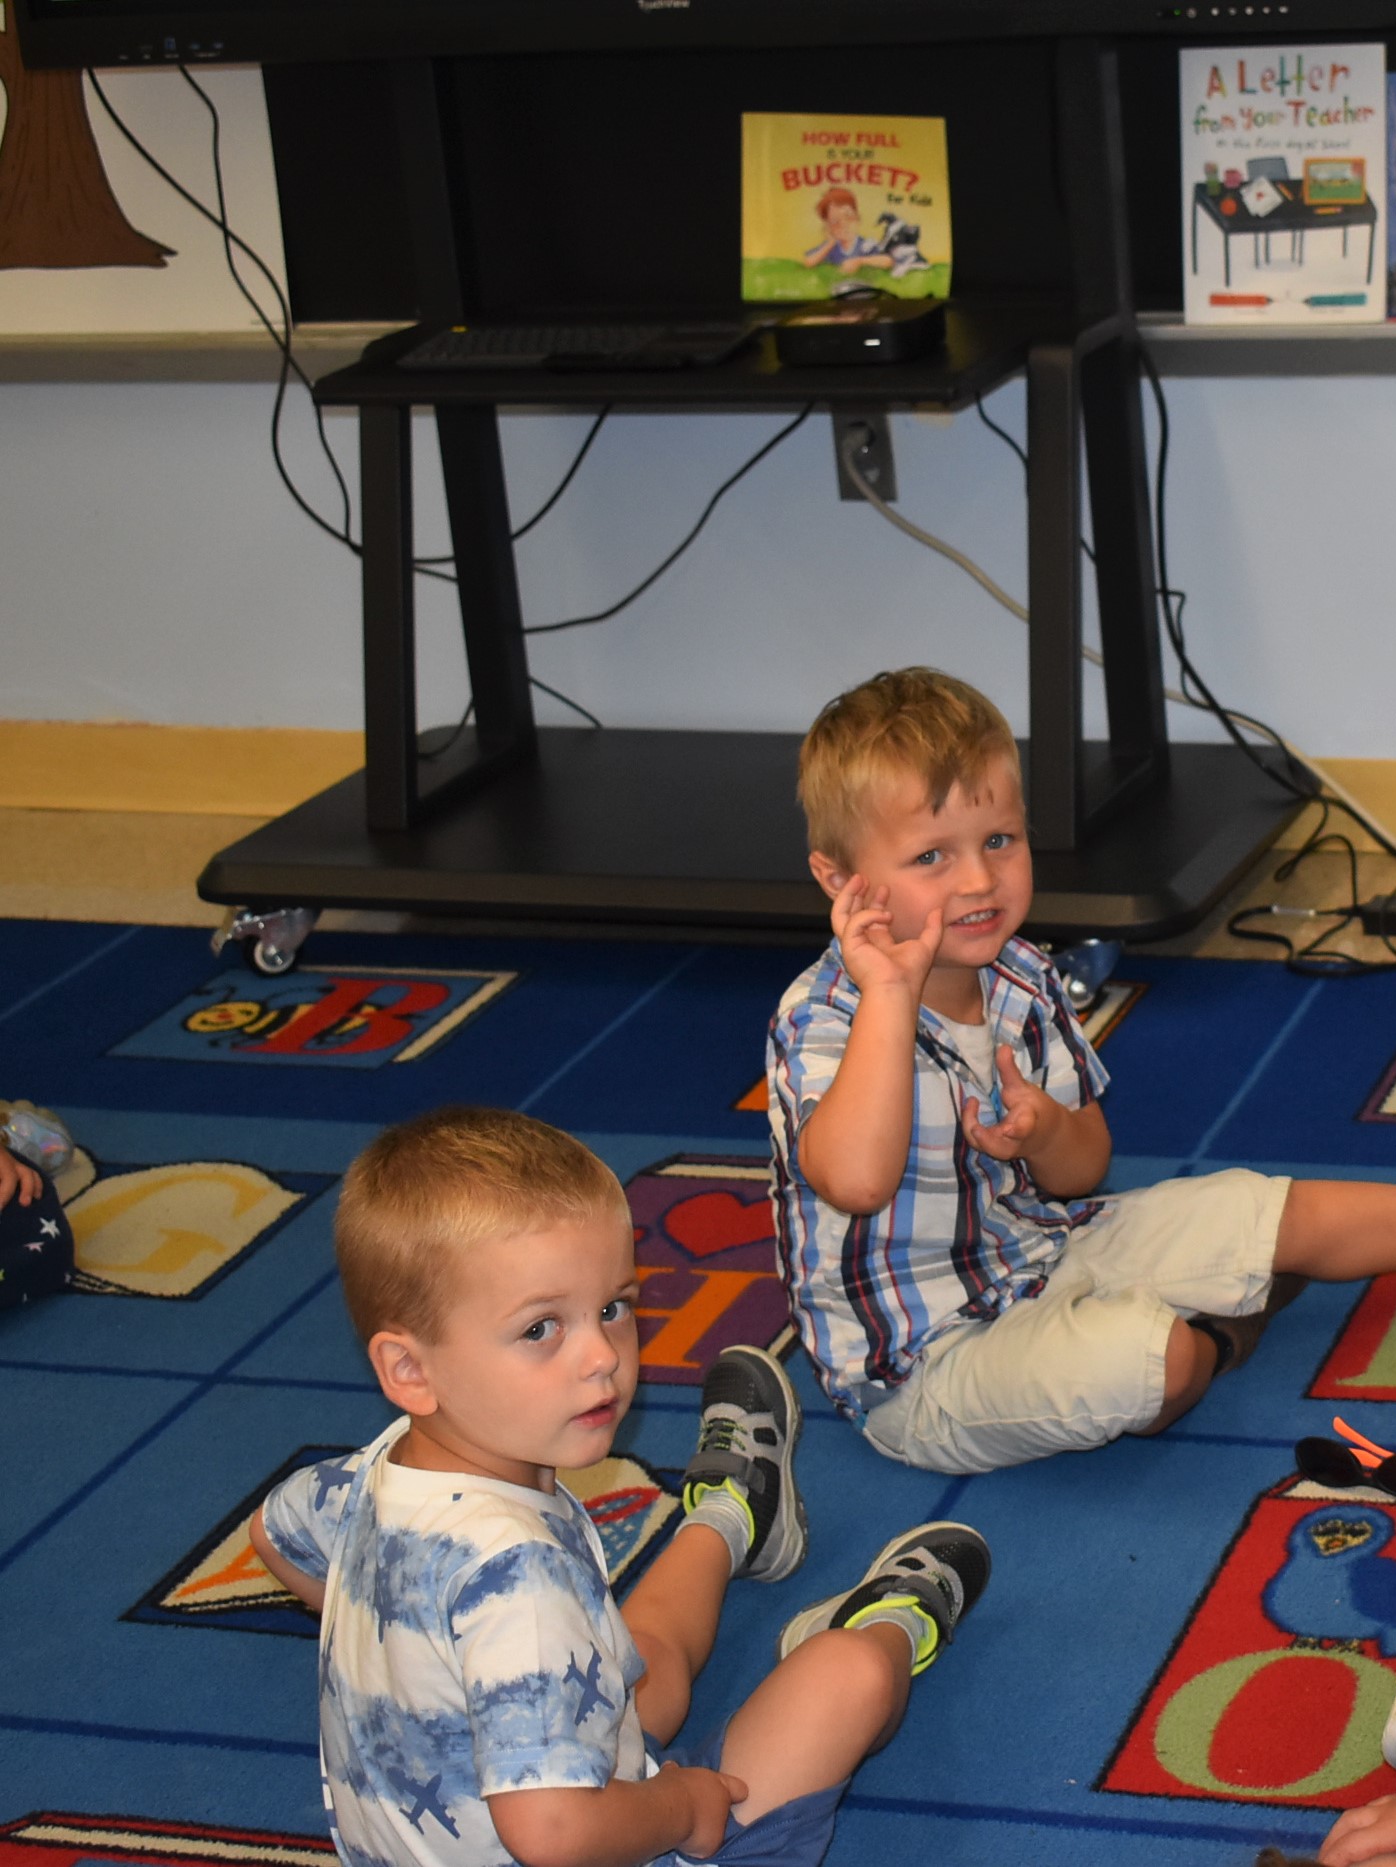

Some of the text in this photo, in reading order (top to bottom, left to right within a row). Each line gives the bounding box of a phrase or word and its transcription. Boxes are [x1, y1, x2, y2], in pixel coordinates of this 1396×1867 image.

[1206, 54, 1351, 99] A Letter
[1285, 96, 1376, 128] Teacher
[802, 131, 902, 148] HOW FULL
[781, 161, 921, 193] BUCKET?
